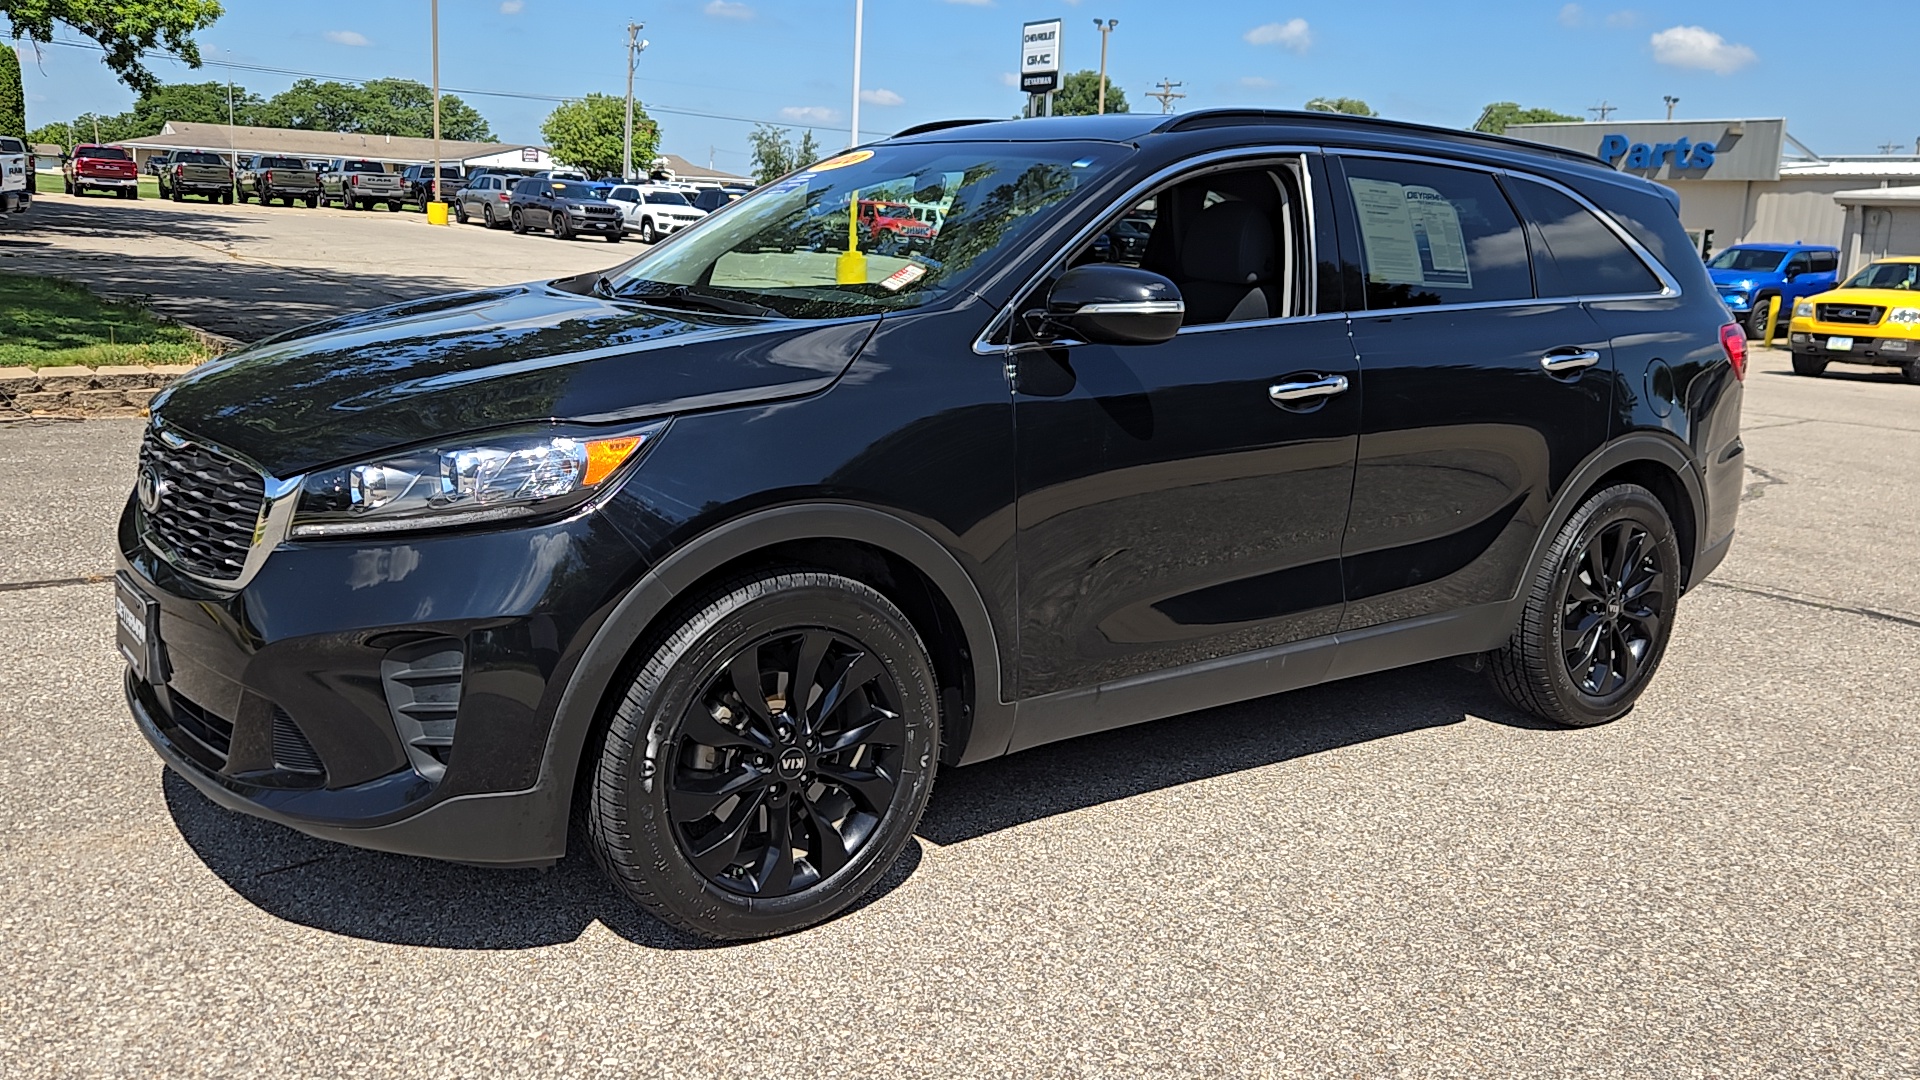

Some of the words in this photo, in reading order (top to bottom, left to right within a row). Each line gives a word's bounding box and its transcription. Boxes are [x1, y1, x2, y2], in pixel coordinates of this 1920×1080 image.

[1024, 31, 1056, 43] CHEVROLET
[1027, 54, 1051, 66] GMC
[1600, 133, 1716, 169] Parts
[782, 757, 804, 770] KIA
